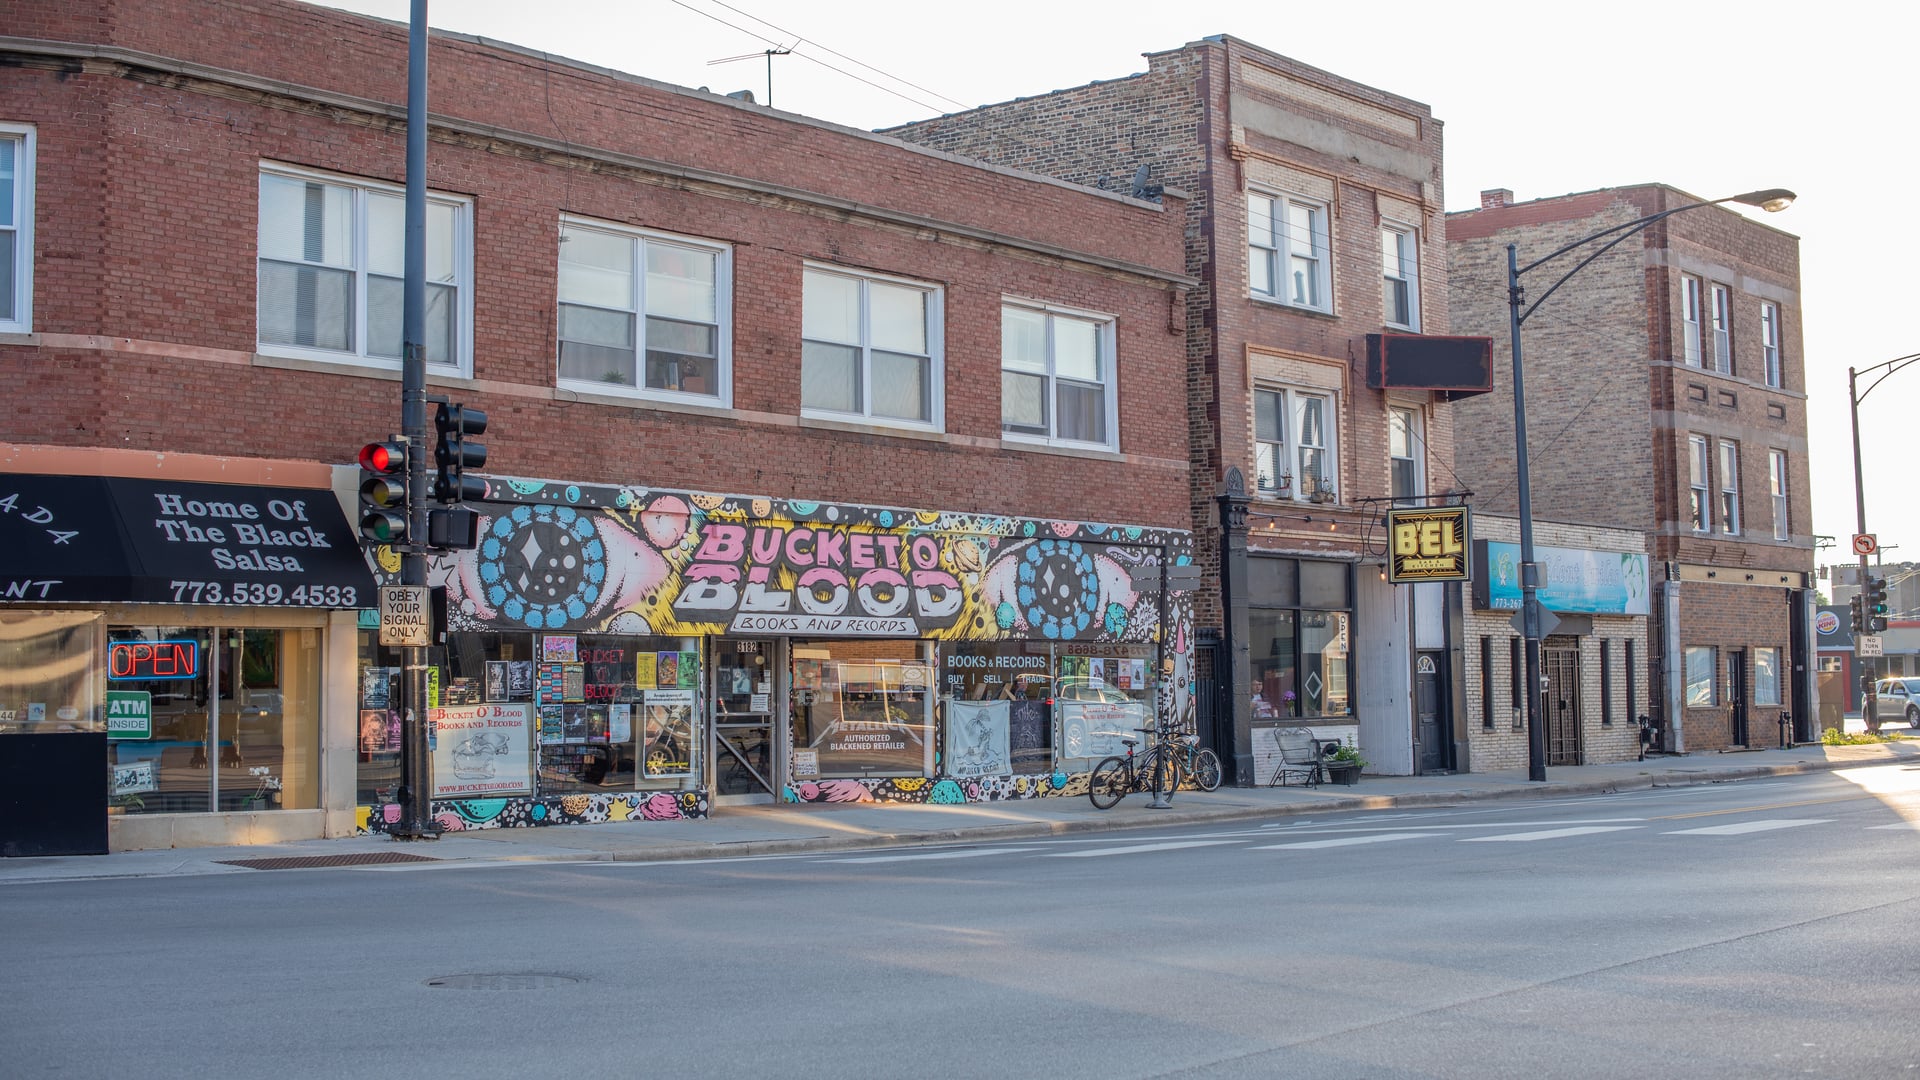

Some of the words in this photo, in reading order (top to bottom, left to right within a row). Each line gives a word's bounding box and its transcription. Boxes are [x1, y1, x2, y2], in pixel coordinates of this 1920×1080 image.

[154, 493, 259, 521] Home
[268, 499, 310, 523] Of
[155, 519, 227, 545] The
[232, 522, 332, 549] Black
[695, 524, 900, 568] BUCKET
[211, 548, 304, 573] Salsa
[0, 579, 63, 599] NT
[170, 579, 358, 607] 773.539.4533
[673, 564, 964, 618] BLOOD
[389, 590, 421, 602] OBEY
[389, 603, 420, 614] YOUR
[384, 614, 426, 626] SIGNAL
[739, 616, 799, 631] BOOKS
[806, 619, 841, 632] AND
[847, 620, 907, 633] RECORDS
[1818, 620, 1836, 628] KING
[390, 627, 419, 638] ONLY
[738, 641, 756, 652] 3182
[111, 644, 196, 677] OPEN
[579, 649, 624, 663] BUCKET
[947, 655, 986, 668] BOOKS
[988, 659, 994, 668] &
[996, 656, 1046, 668] RECORDS
[948, 675, 965, 683] BUY
[983, 675, 1003, 683] SELL
[1021, 675, 1046, 683] TRADE
[109, 700, 147, 714] ATM
[437, 708, 474, 720] BUCKET
[493, 706, 523, 718] BLOOD
[110, 720, 145, 729] INSIDE
[437, 722, 465, 730] BOOKS
[467, 721, 484, 729] AND
[487, 719, 523, 728] RECORDS
[844, 734, 891, 742] AUTHORIZED
[830, 742, 872, 751] BLACKENED
[873, 742, 905, 750] RETAILER
